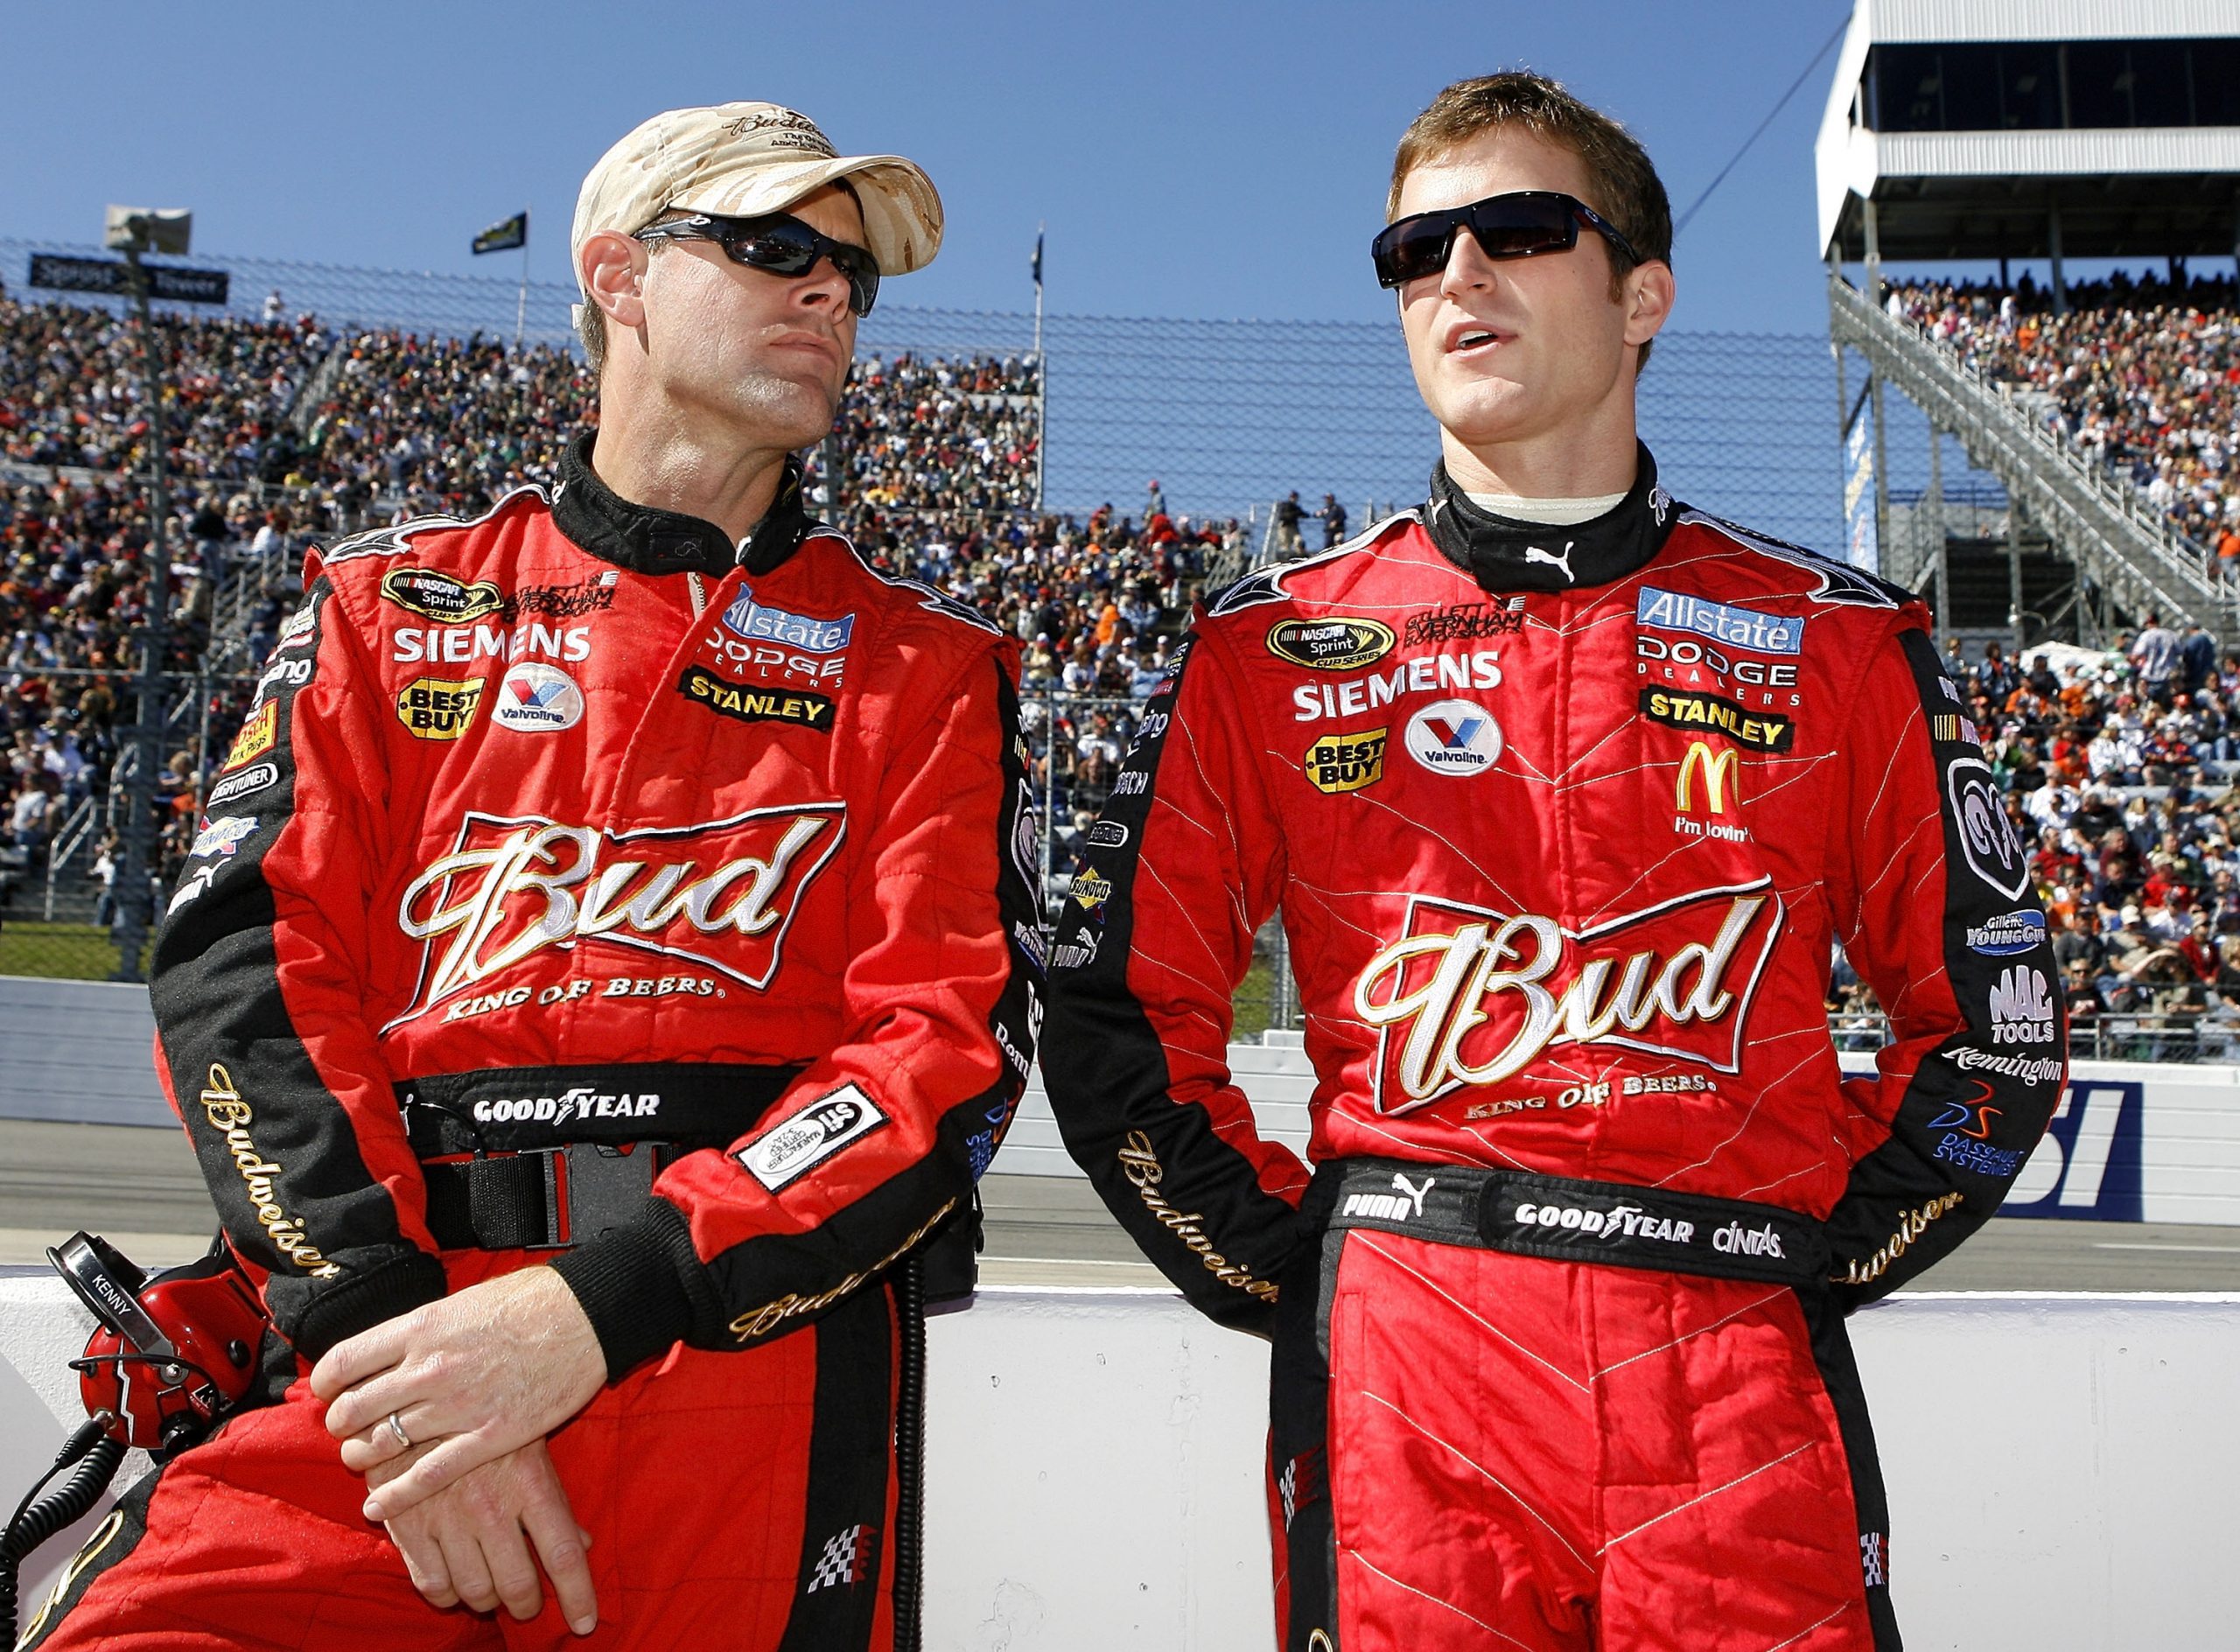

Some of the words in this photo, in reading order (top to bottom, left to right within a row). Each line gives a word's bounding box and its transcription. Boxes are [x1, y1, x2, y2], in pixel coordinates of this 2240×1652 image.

[413, 578, 461, 596] NASCAR
[422, 592, 466, 608] Sprint
[1300, 625, 1347, 641] NASCAR
[1642, 592, 1790, 650] Allstate
[394, 623, 591, 663] SIEMENS
[1310, 637, 1354, 655] Sprint
[1316, 656, 1342, 668] CUP
[1341, 650, 1382, 665] SERIES
[1637, 636, 1797, 686] DODGE
[409, 688, 481, 711] BEST
[690, 676, 826, 722] STANLEY
[1292, 651, 1502, 722] SIEMENS
[410, 710, 475, 732] BUY
[1650, 693, 1785, 746] STANLEY
[1315, 735, 1386, 766] BEST
[1319, 757, 1383, 785] BUY
[1674, 816, 1702, 836] I'm
[1705, 821, 1749, 844] lovin'
[1070, 878, 1110, 900] SUNOCO
[399, 816, 830, 1004] Bud
[1986, 914, 2024, 930] Gillette
[439, 985, 532, 1025] KING
[537, 979, 595, 1006] OF
[1354, 895, 1768, 1100] Bud
[1989, 964, 2054, 1023] MAC
[1991, 1020, 2054, 1044] TOOLS
[1941, 1046, 2063, 1088] Remington
[1463, 1096, 1546, 1120] KING
[1557, 1080, 1611, 1110] OF
[1941, 1132, 2026, 1164] DASSAULT
[200, 1062, 341, 1280] Budweiser
[1117, 1130, 1280, 1304] Budweiser
[1342, 1193, 1410, 1222] PUMA
[92, 1273, 132, 1316] KENNY
